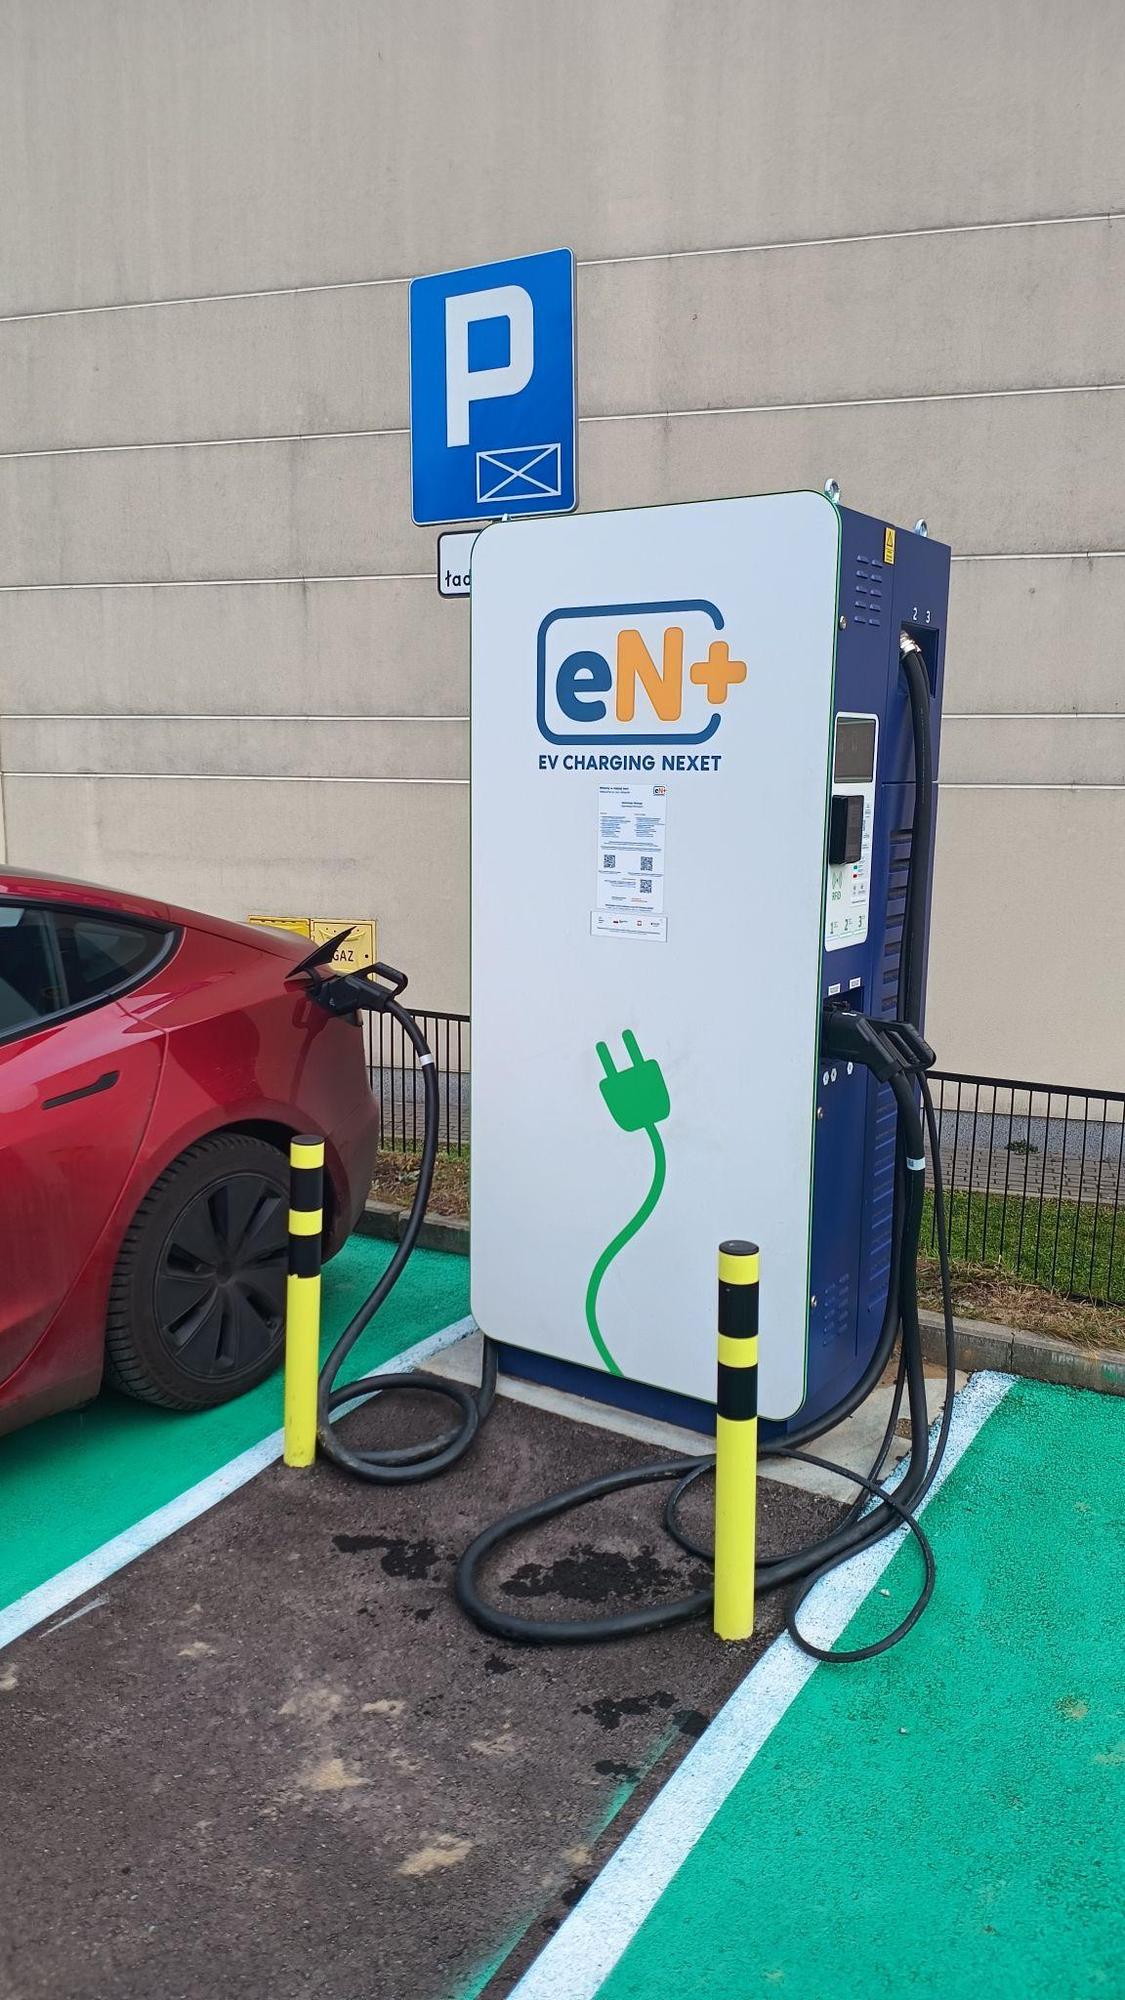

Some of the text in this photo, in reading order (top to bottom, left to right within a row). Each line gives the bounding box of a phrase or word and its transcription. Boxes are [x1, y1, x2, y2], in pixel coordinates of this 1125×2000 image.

[445, 284, 534, 448] P
[912, 607, 931, 624] 2 3
[538, 754, 722, 772] EV CHARGING NEXET
[332, 949, 354, 962] GAZ
